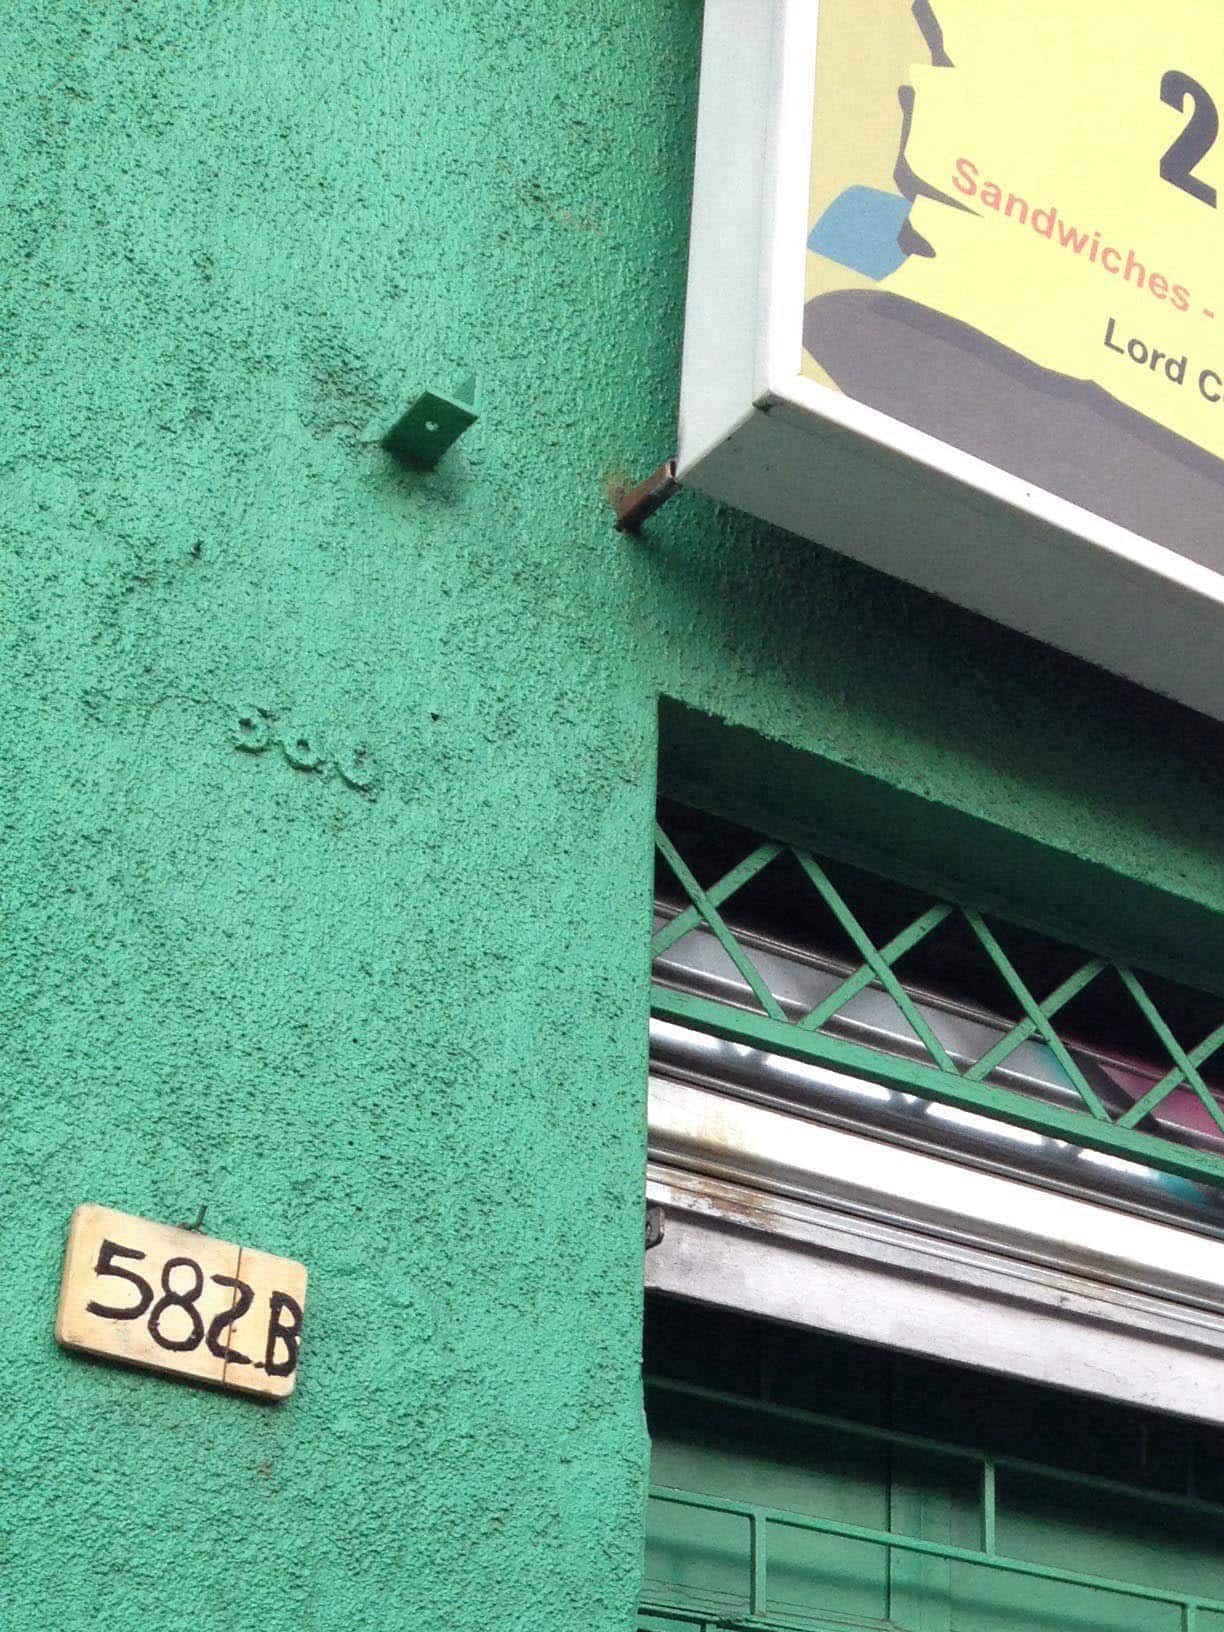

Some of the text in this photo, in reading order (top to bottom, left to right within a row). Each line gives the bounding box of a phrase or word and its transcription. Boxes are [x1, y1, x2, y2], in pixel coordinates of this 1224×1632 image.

[1159, 70, 1219, 209] 2
[952, 158, 1190, 313] Sandwiches
[1104, 318, 1187, 385] Lord
